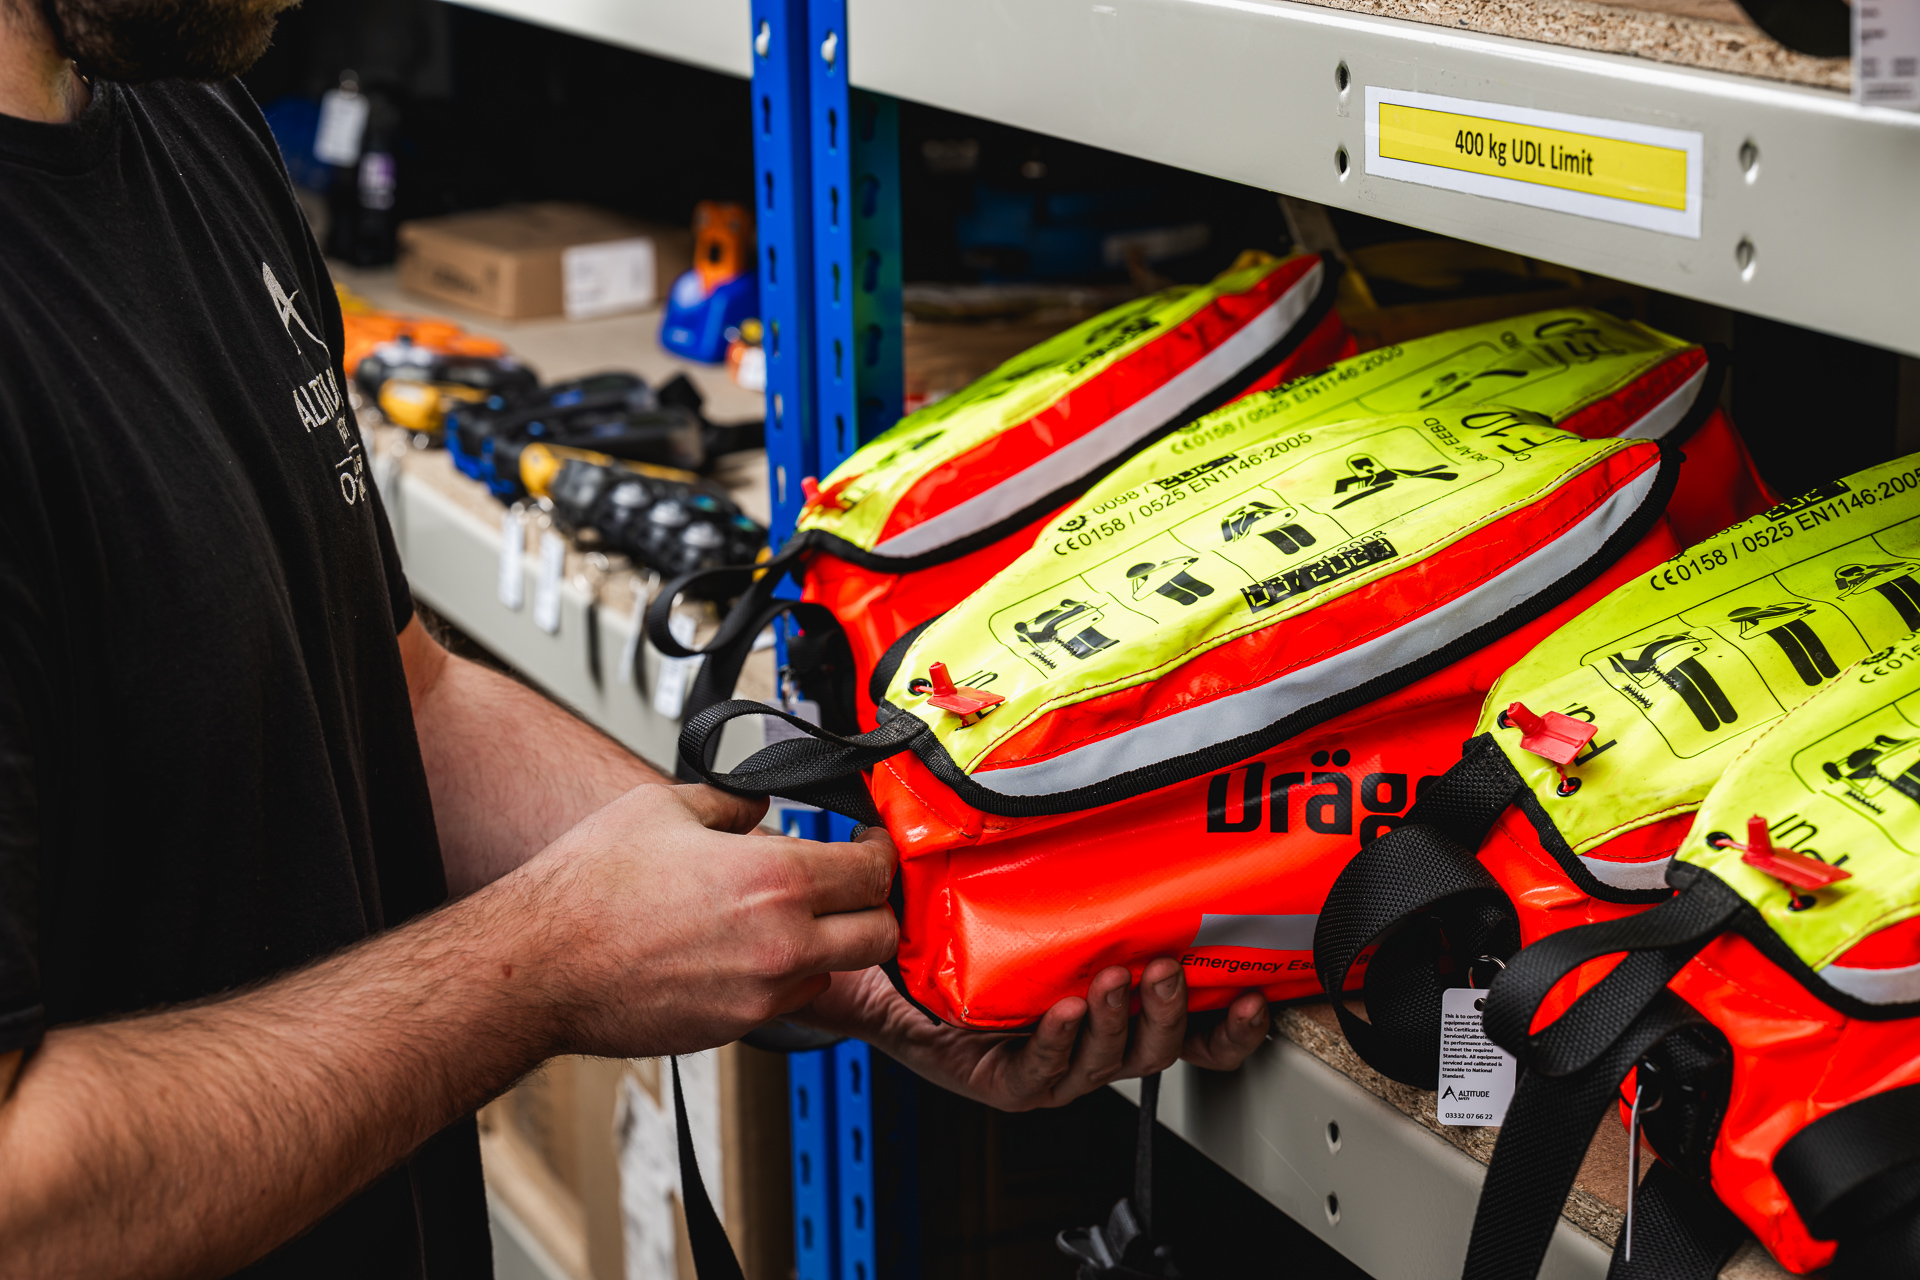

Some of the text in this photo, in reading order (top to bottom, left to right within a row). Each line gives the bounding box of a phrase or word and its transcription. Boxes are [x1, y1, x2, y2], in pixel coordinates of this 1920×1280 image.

[1455, 130, 1593, 176] 400 kg UDL Limit
[1424, 418, 1460, 446] EEBD
[1139, 488, 1186, 518] 0525
[1188, 431, 1313, 493] EN1146:2005
[1742, 520, 1794, 553] 0525
[1180, 954, 1283, 973] Emergency
[1458, 1090, 1490, 1098] ALTITUDE
